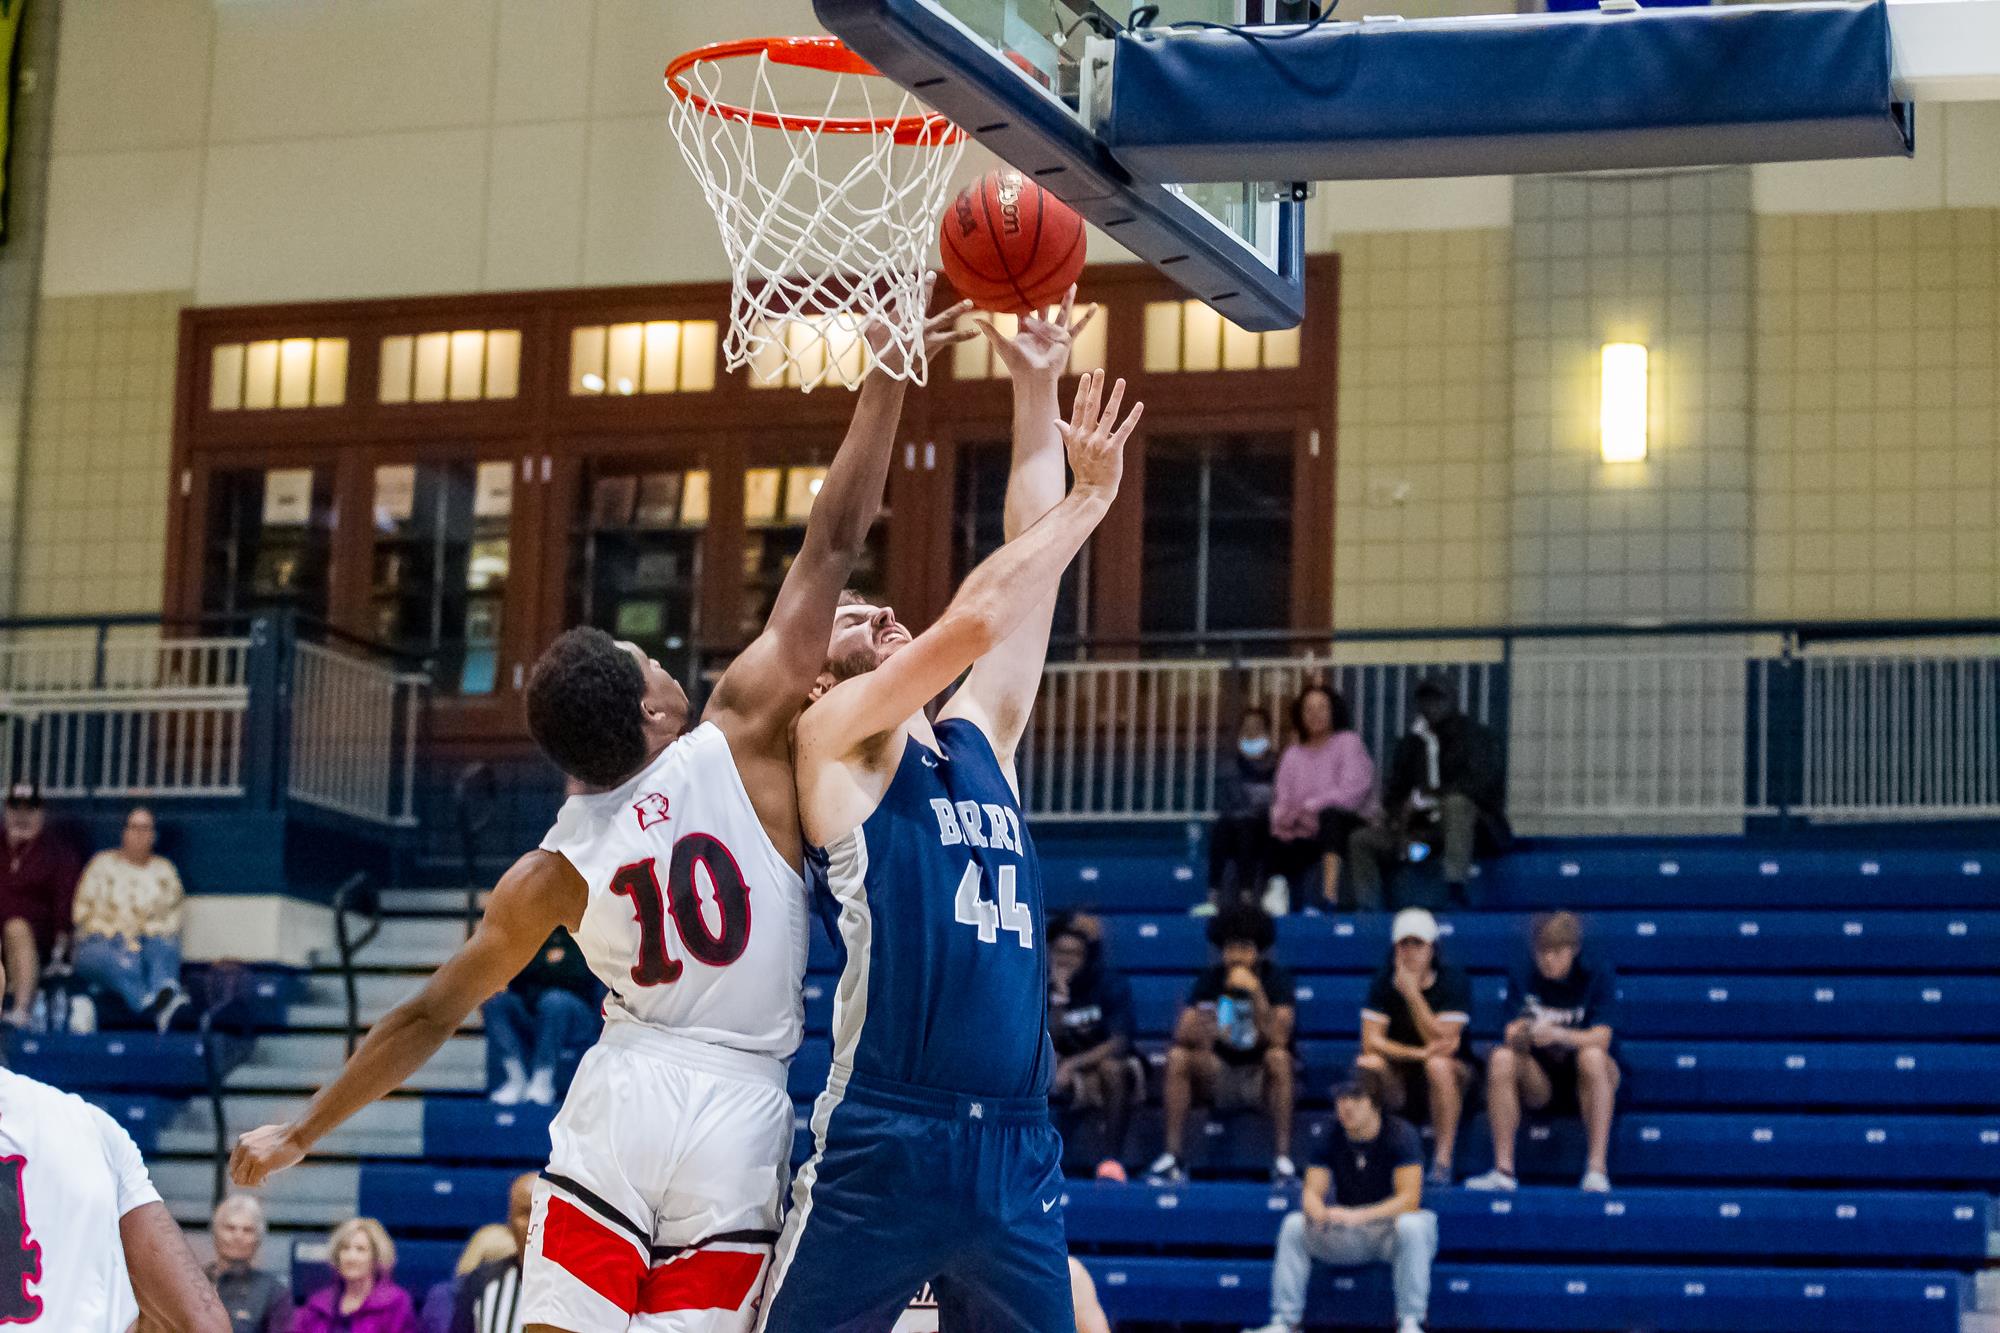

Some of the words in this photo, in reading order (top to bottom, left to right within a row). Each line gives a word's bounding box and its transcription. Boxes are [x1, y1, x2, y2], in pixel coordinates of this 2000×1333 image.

[929, 798, 1024, 857] BRRY
[610, 832, 751, 987] 10
[955, 859, 1033, 949] 44
